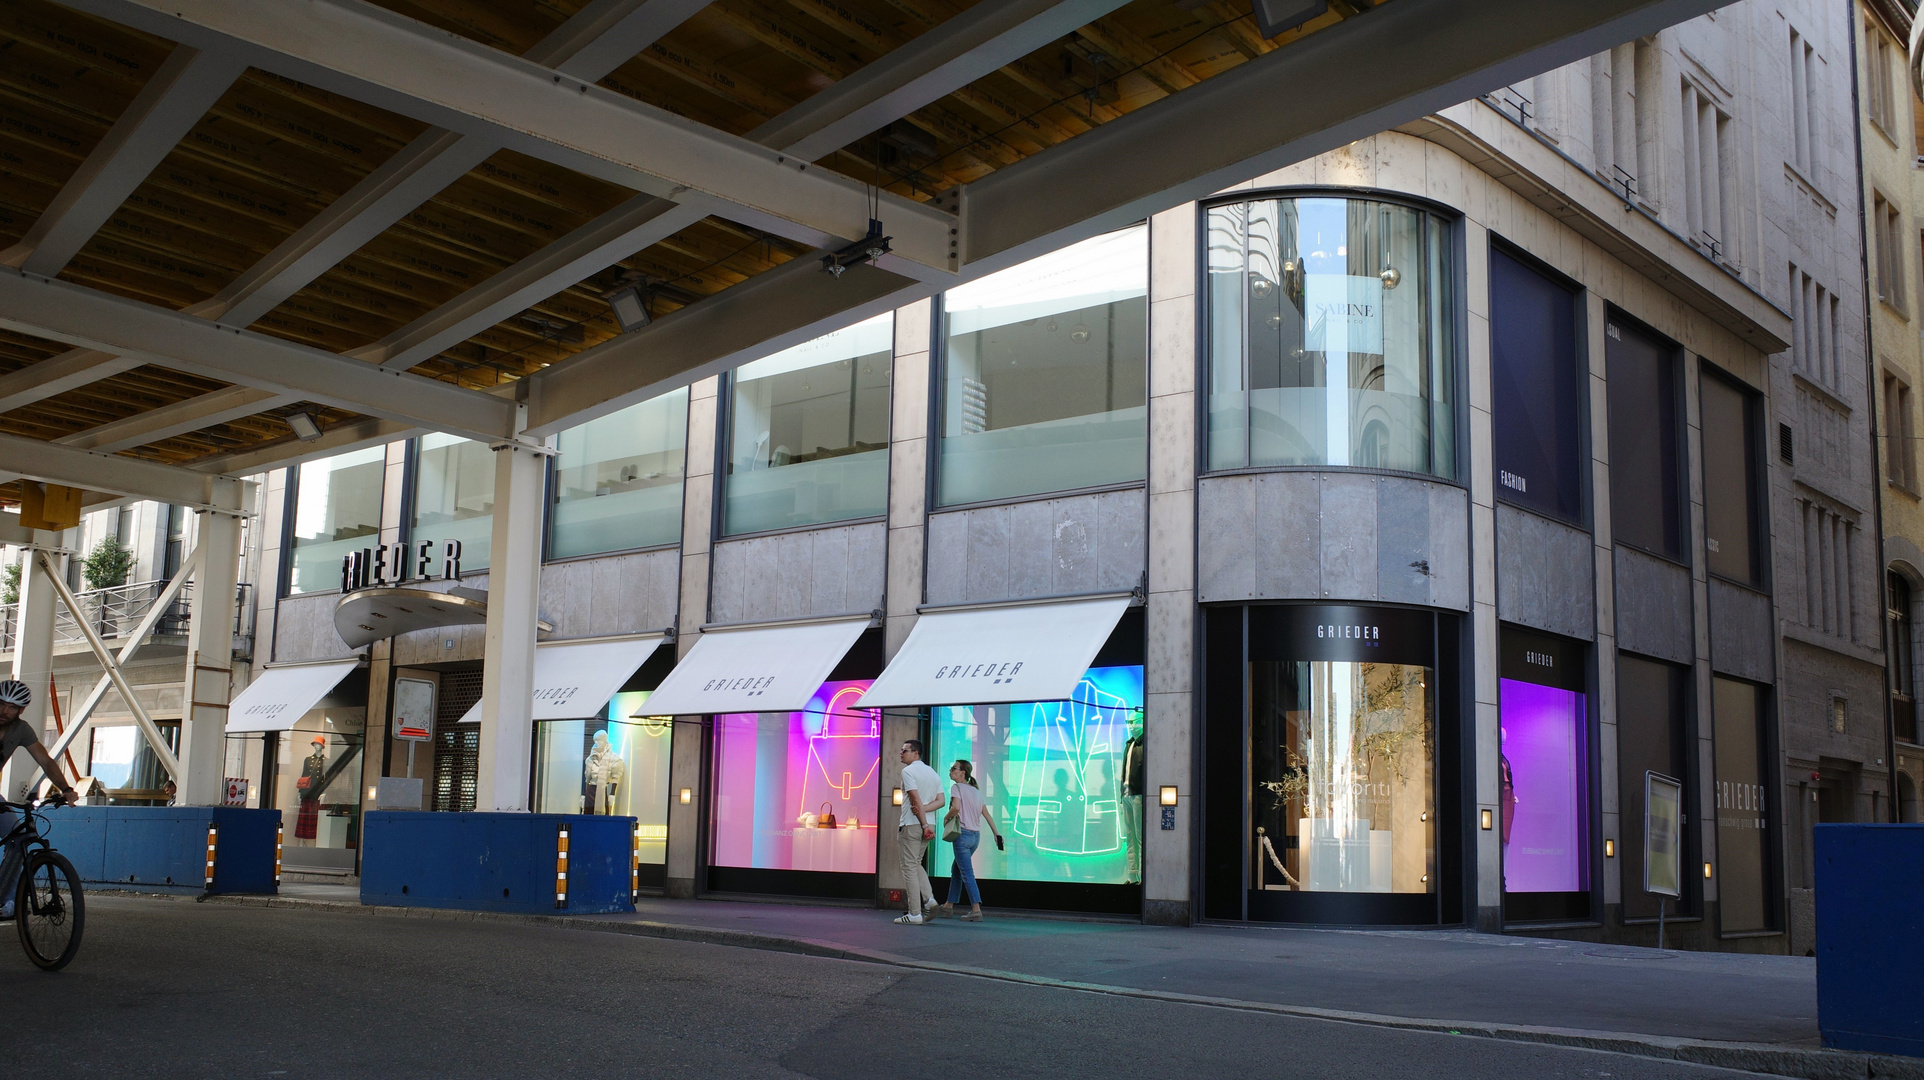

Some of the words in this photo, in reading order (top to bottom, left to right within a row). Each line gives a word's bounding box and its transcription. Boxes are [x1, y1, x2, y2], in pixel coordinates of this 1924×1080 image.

[1315, 302, 1374, 318] SABINE
[1501, 470, 1526, 493] FASHION
[1317, 624, 1379, 640] GRIEDER
[1526, 650, 1553, 668] GRIEDER
[935, 661, 1024, 679] GRIEDER
[703, 676, 775, 691] GRIEDER
[533, 687, 579, 700] RIEDER
[245, 703, 288, 715] GRIEDER
